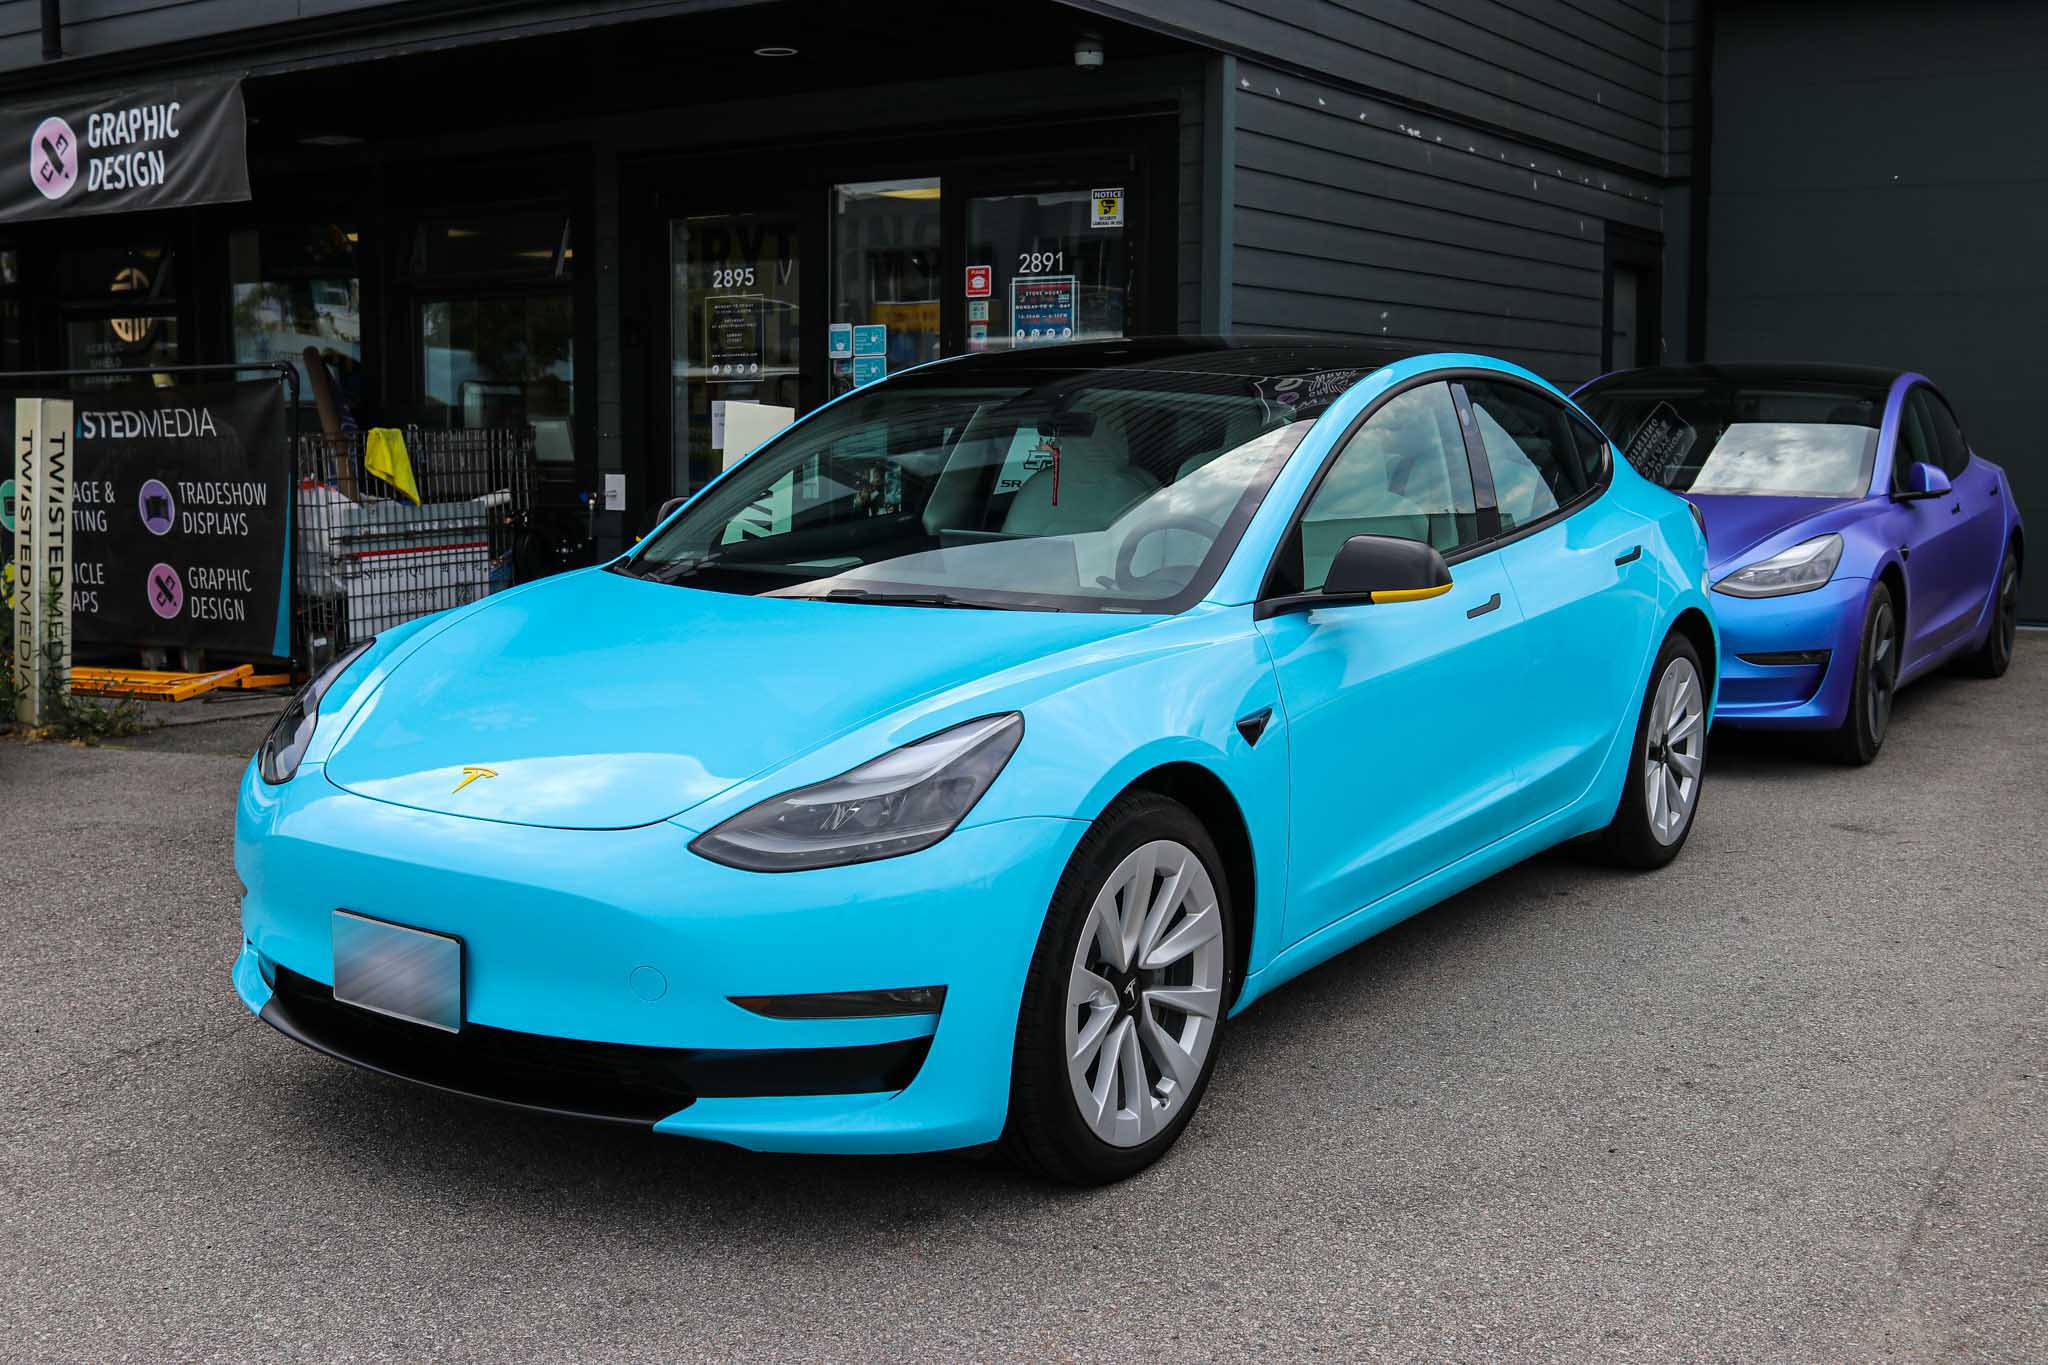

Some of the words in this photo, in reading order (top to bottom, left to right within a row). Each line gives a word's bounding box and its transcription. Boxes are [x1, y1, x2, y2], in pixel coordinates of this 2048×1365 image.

[88, 102, 180, 148] GRAPHIC
[88, 151, 165, 191] DESIGN
[1018, 251, 1064, 273] 2891
[712, 267, 755, 288] 2895
[72, 481, 100, 503] AGE
[104, 481, 116, 503] &
[178, 482, 267, 506] TRADESHOW
[72, 510, 108, 532] TING
[183, 512, 249, 536] DISPLAYS
[19, 429, 34, 692] TWISTEDMEDIA
[48, 431, 65, 690] TWISTEDMEDI
[72, 562, 105, 585] ICLE
[188, 567, 252, 592] GRAPHIC
[72, 591, 99, 613] APS
[191, 596, 245, 621] DESIGN
